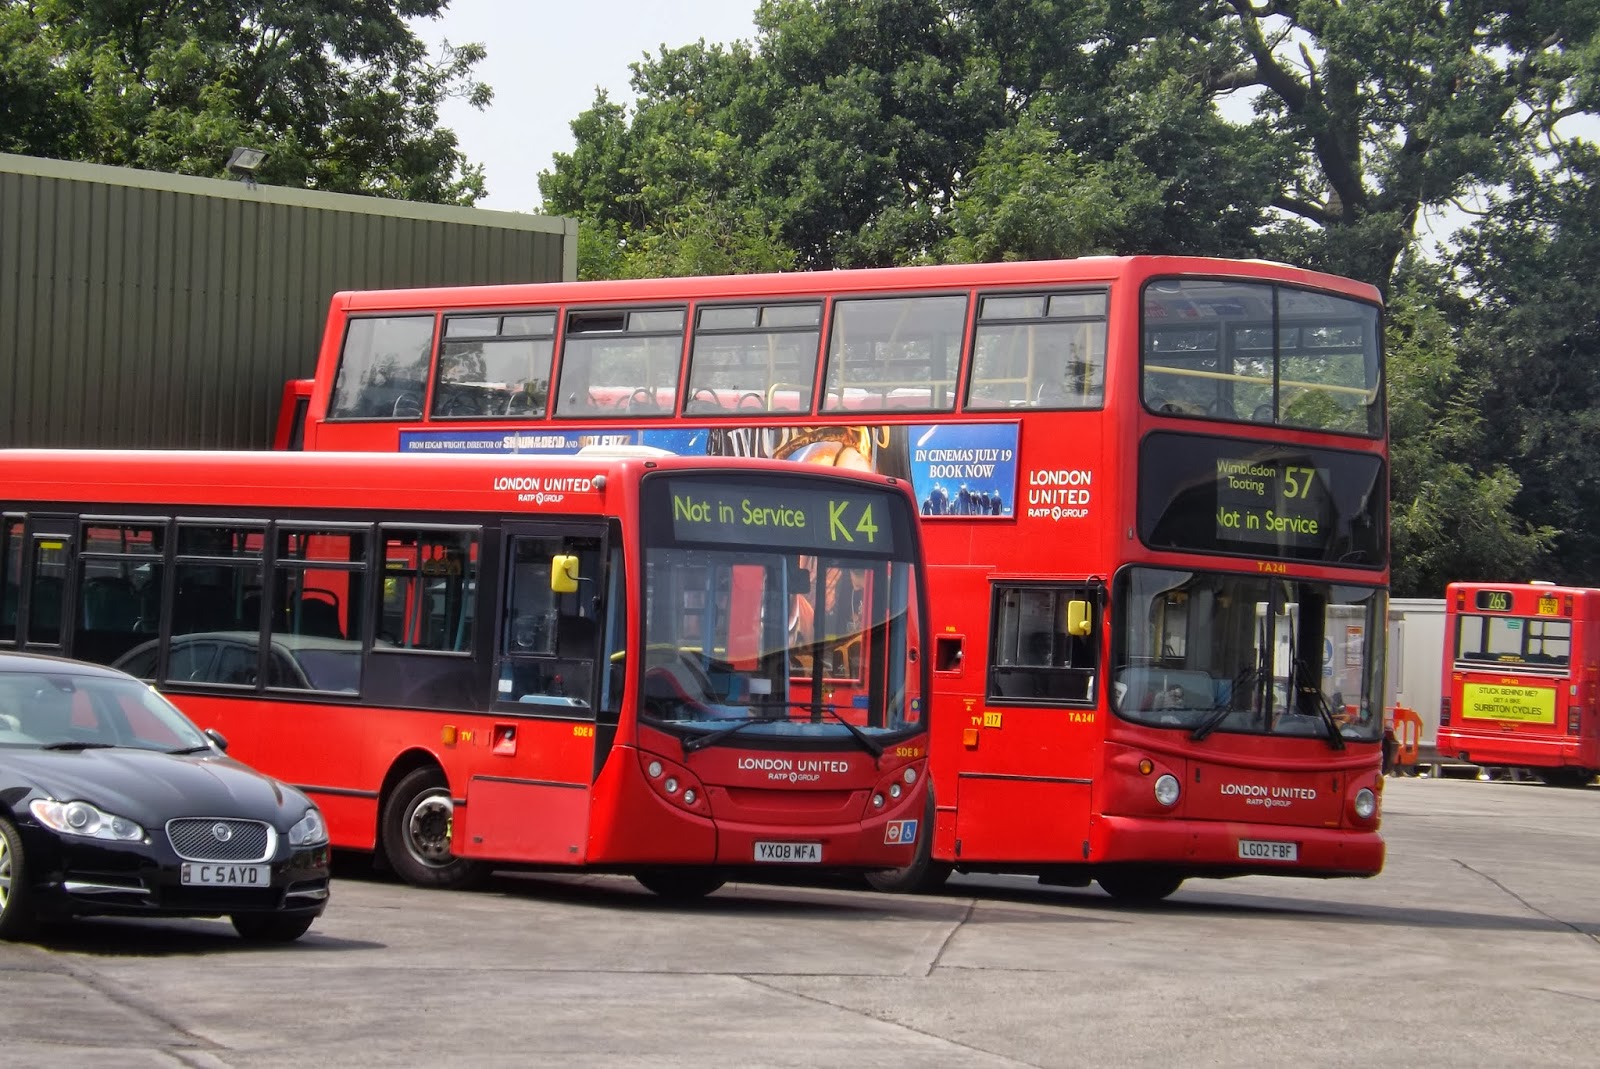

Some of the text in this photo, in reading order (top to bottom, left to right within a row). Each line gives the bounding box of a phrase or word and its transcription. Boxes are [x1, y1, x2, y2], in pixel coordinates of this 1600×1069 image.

[409, 441, 424, 449] FROM
[424, 441, 442, 449] EDGAR
[466, 441, 494, 449] DIRECTOR
[494, 441, 502, 449] OF
[915, 449, 1012, 464] IN CINEMAS JULY 19
[929, 464, 995, 478] BOOK NOW
[1217, 460, 1276, 477] Wimbledon
[494, 477, 591, 492] LONDON UNITED
[1029, 470, 1092, 485] LONDON
[1283, 466, 1315, 499] 57
[1228, 476, 1265, 495] Tooting
[518, 494, 535, 502] RATP
[1028, 489, 1090, 504] UNITED
[674, 495, 806, 528] Not in Service
[1027, 508, 1089, 518] RATP GROUP
[829, 500, 879, 543] K4
[1246, 511, 1260, 529] in
[1265, 510, 1318, 534] Service
[1257, 562, 1286, 573] TA241
[1489, 592, 1506, 610] 265
[1479, 687, 1499, 695] STUCK
[1501, 688, 1523, 696] BEHIND
[1474, 703, 1542, 715] SURBITON CYCLES
[971, 717, 982, 725] TV
[1069, 713, 1095, 723] TA241
[461, 732, 472, 741] TV
[573, 726, 588, 737] SDE
[896, 747, 913, 757] SDE
[738, 758, 848, 773] LONDON UNITED
[1221, 784, 1317, 800] LONDON UNITED
[1246, 798, 1291, 807] RATP GROUP
[760, 844, 816, 859] YX08 MFA
[1242, 843, 1292, 858] LG02 FBF
